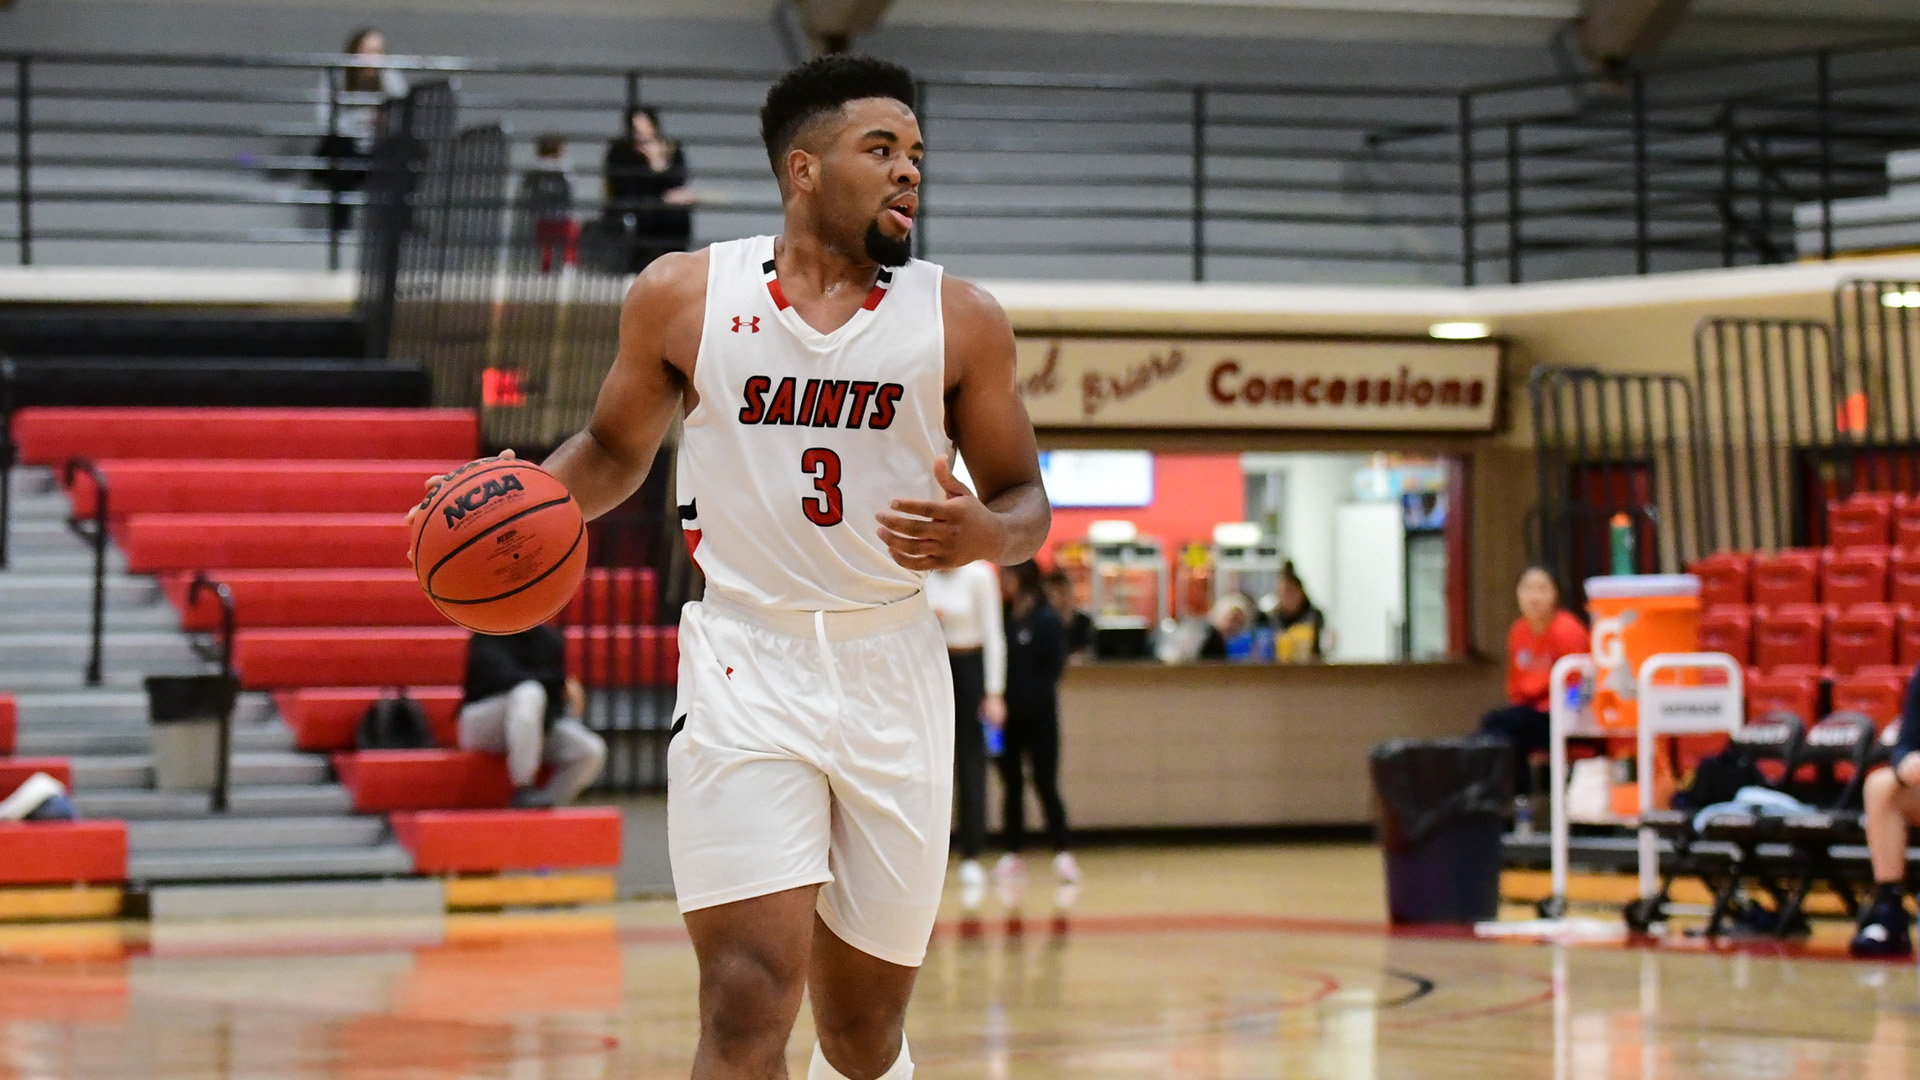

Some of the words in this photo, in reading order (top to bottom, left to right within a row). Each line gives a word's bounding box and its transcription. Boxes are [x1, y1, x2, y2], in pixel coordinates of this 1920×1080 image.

[739, 376, 904, 430] SAINTS
[1207, 361, 1484, 406] Concessions
[443, 474, 524, 529] NCAA
[801, 447, 843, 527] 3
